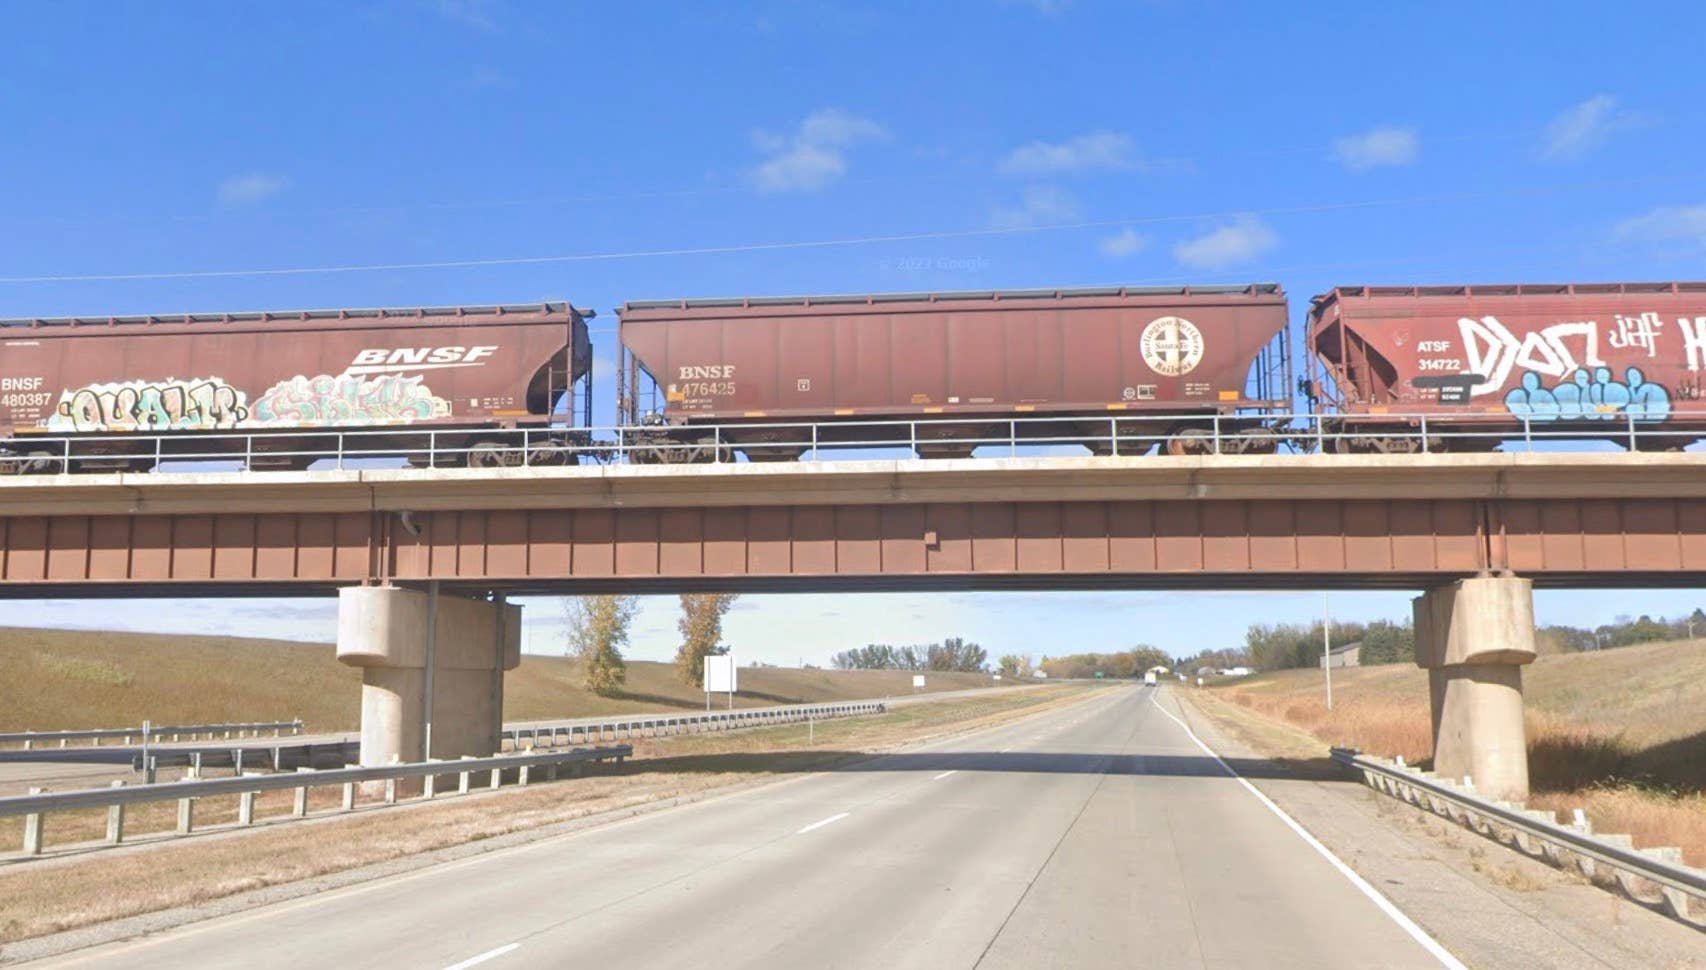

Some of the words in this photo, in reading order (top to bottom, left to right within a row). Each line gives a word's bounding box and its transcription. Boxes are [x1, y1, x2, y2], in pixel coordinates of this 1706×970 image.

[1143, 320, 1173, 359] Burlington
[1418, 341, 1450, 352] ATSF
[352, 345, 499, 364] BNSF
[1418, 359, 1461, 370] 314722
[679, 365, 736, 380] BNSF
[1, 377, 43, 390] BNSF
[682, 382, 736, 396] 476425
[1, 392, 52, 407] 480387
